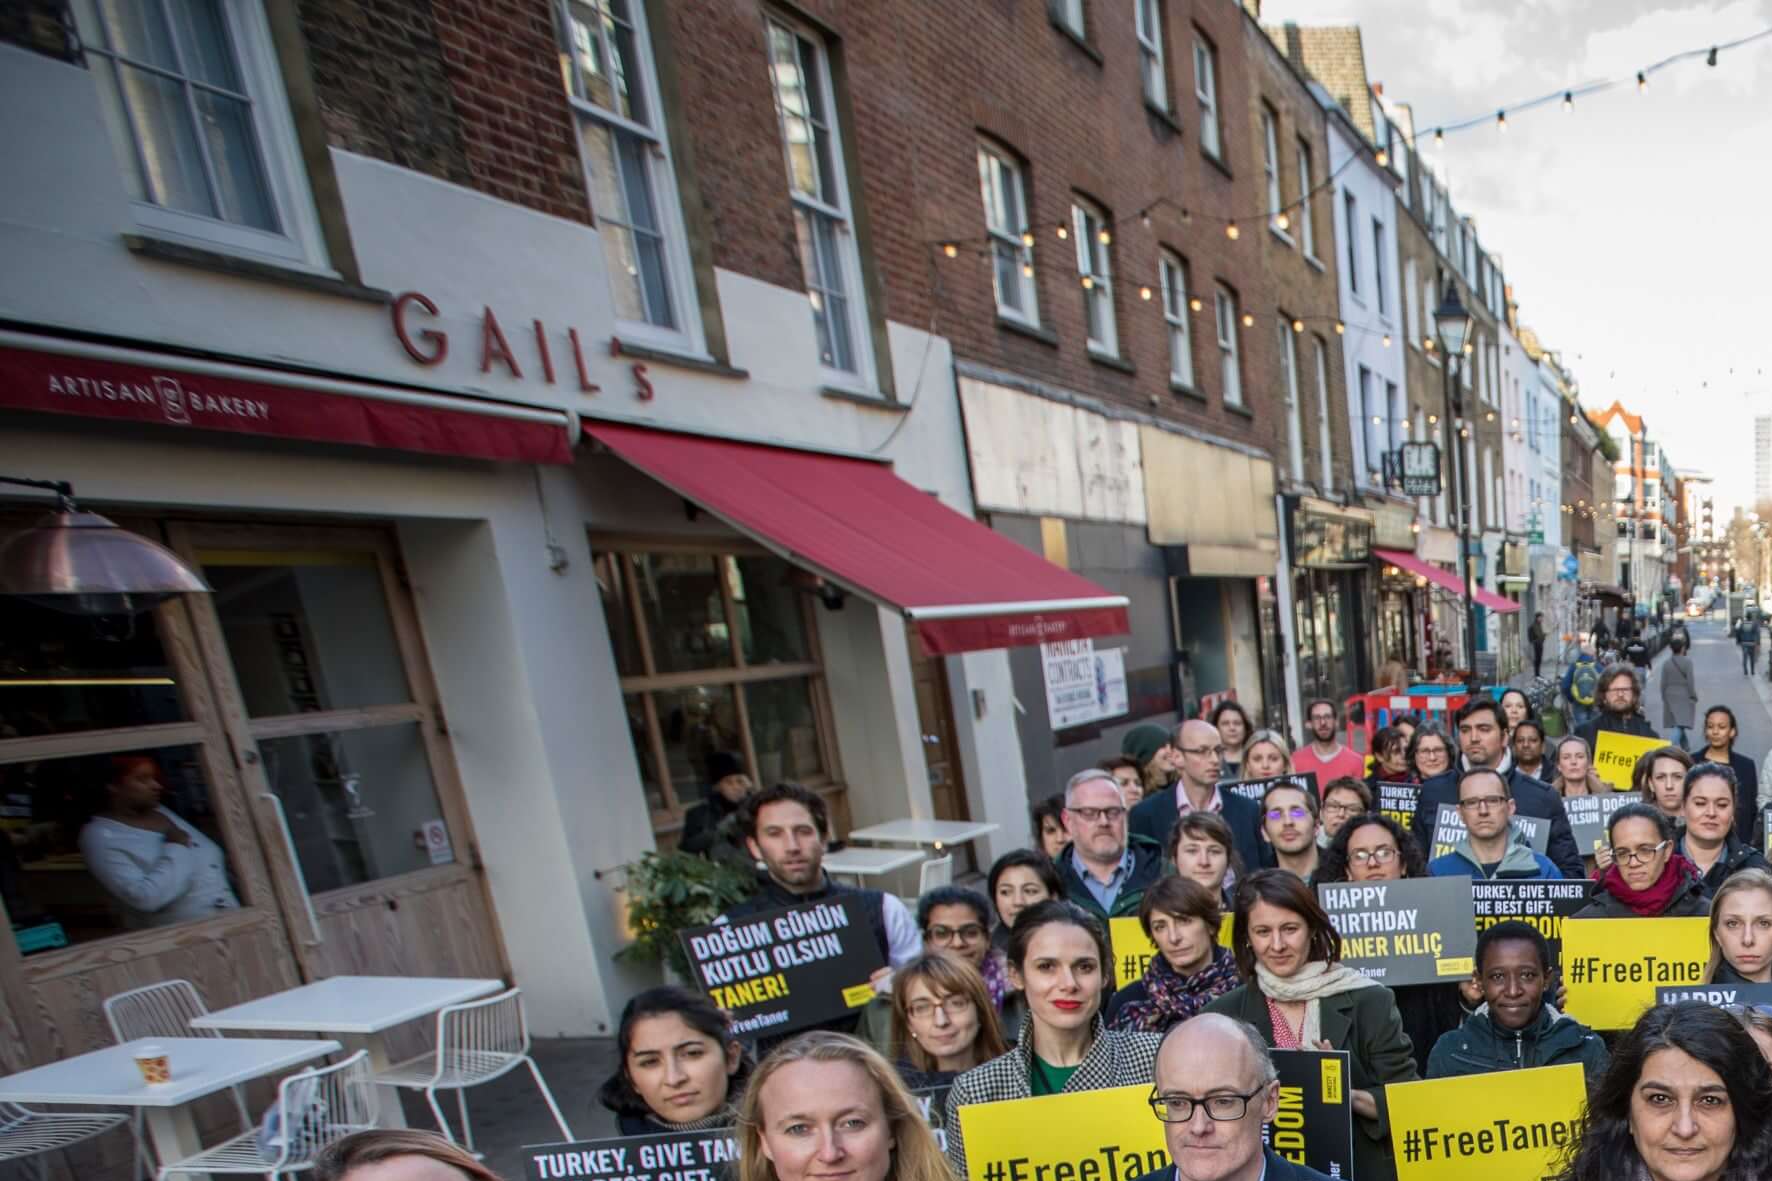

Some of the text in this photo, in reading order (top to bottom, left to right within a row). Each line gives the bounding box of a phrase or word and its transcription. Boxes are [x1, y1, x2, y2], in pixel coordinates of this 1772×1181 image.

[50, 374, 269, 420] ARTISAN BAKERY
[1398, 800, 1418, 811] BES
[1325, 886, 1388, 910] HAPPY
[1471, 884, 1584, 900] TURKEY, GIVE TANER
[1494, 901, 1523, 914] BEST
[1525, 901, 1554, 915] GIFT:
[691, 904, 849, 961] DOĞUM GÜNÜN
[1329, 909, 1418, 934] BIRTHDAY
[1333, 932, 1443, 960] ANER KILIÇ
[700, 933, 844, 986] KUTLU OLSUN
[708, 973, 790, 1010] TANER!
[729, 1009, 790, 1034] FreeTaner
[534, 1138, 742, 1179] TURKEY, GIVE TAN
